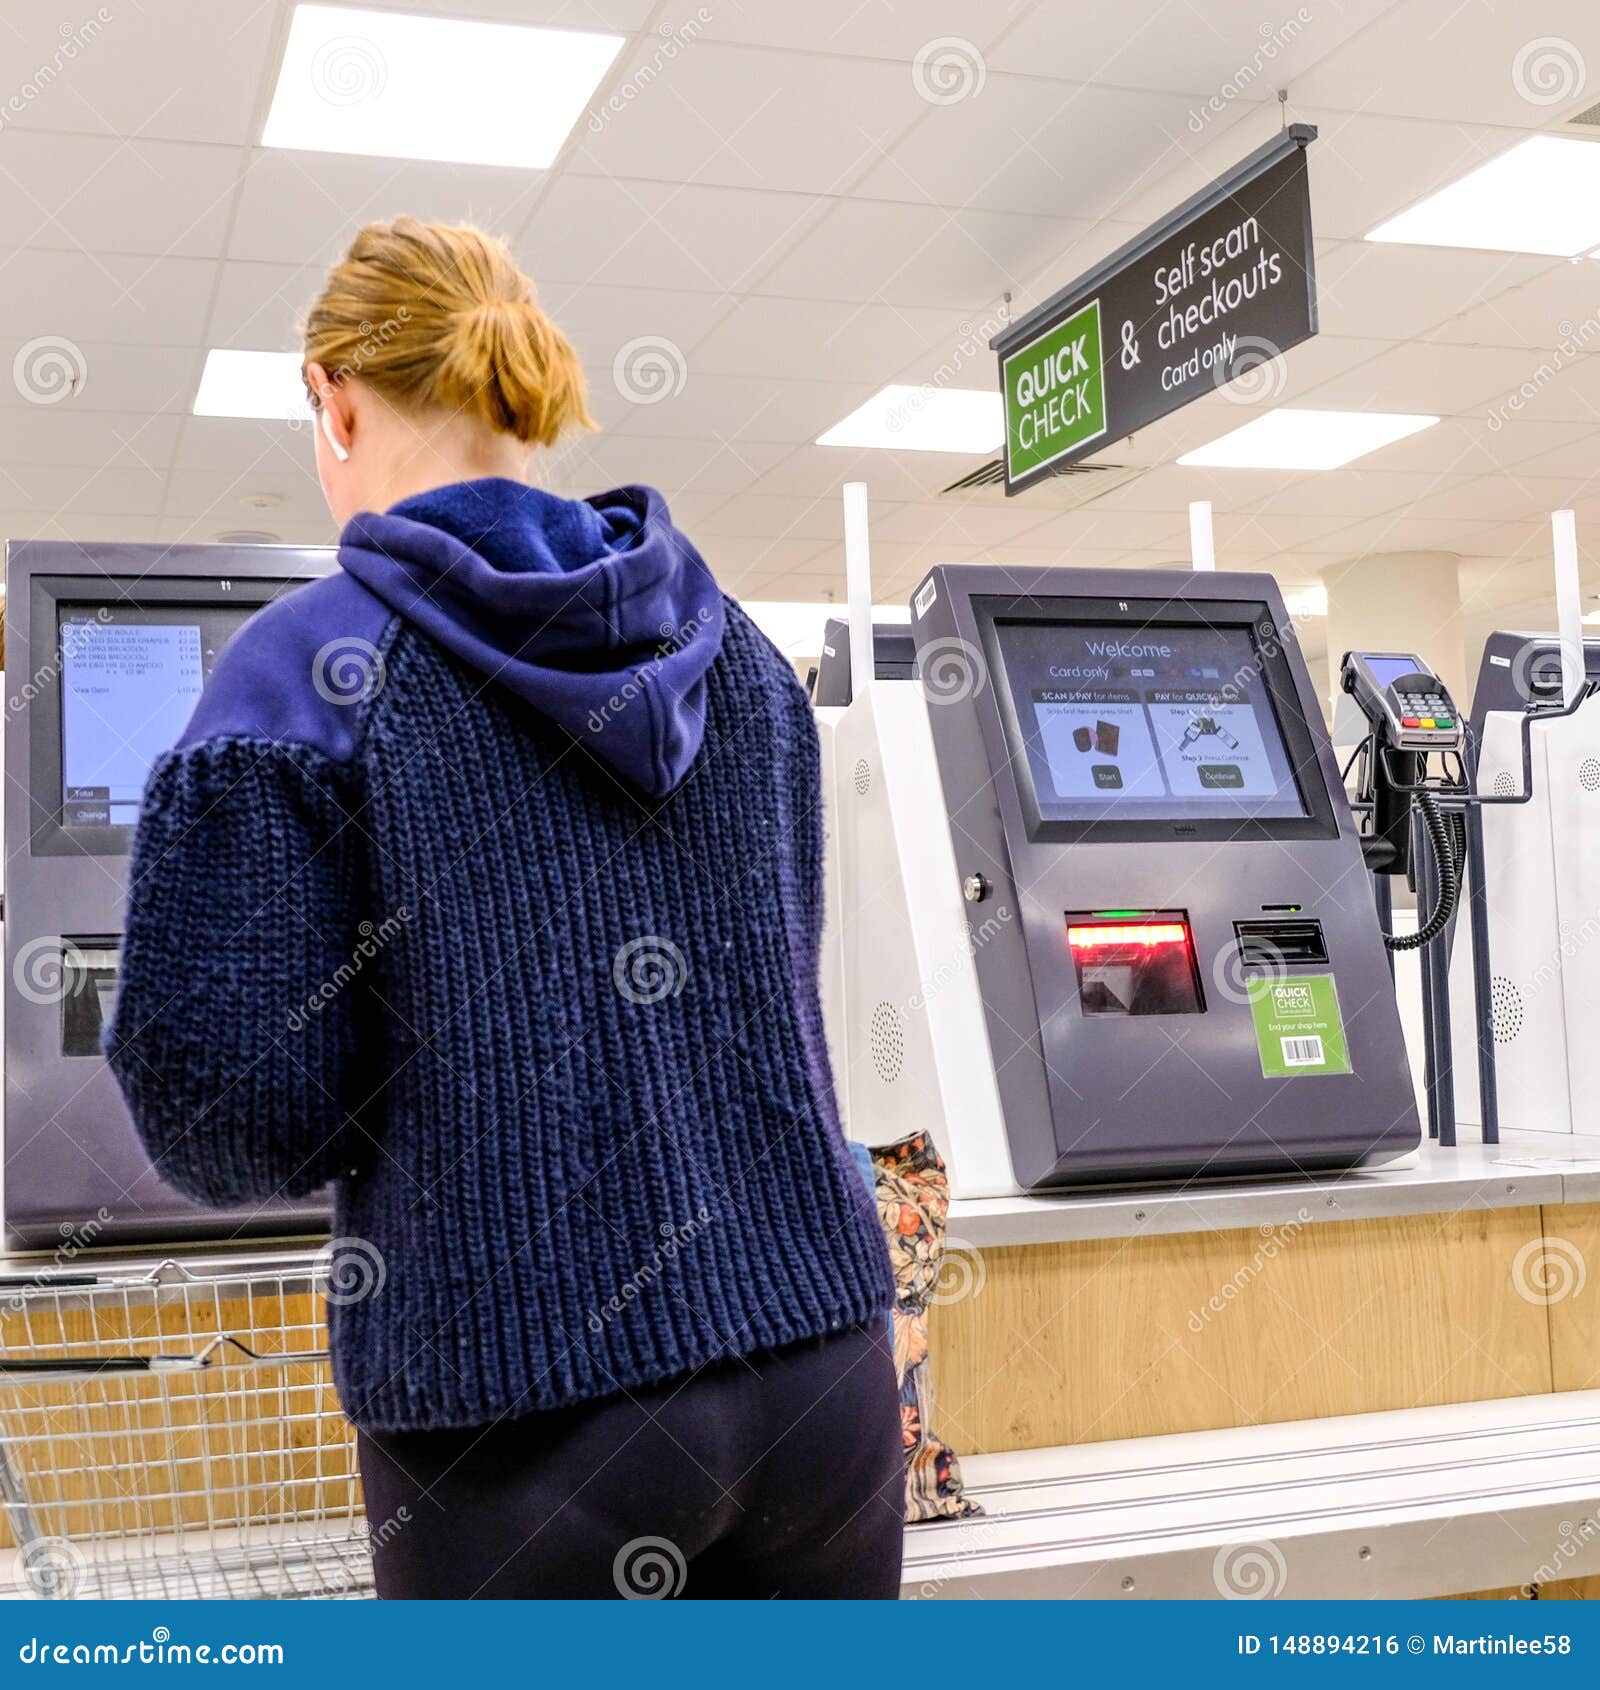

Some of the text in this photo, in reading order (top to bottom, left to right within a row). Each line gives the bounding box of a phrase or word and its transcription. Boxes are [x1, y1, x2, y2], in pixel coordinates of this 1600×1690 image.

[1154, 217, 1259, 305] Self scan
[1158, 248, 1282, 349] checkouts
[1120, 320, 1141, 370] &
[1162, 332, 1237, 391] Card only
[1016, 334, 1089, 407] QUICK
[1019, 379, 1092, 449] CHECK
[1085, 640, 1171, 657] Welcome
[1049, 665, 1109, 681] Card only
[1041, 691, 1068, 701] SCAN
[1076, 691, 1093, 701] PAY
[1154, 692, 1171, 701] PAY
[1275, 986, 1308, 998] QUICK
[1277, 998, 1311, 1009] CHECK
[1268, 1023, 1281, 1031] End
[1281, 1023, 1296, 1032] your
[1296, 1022, 1312, 1031] shop
